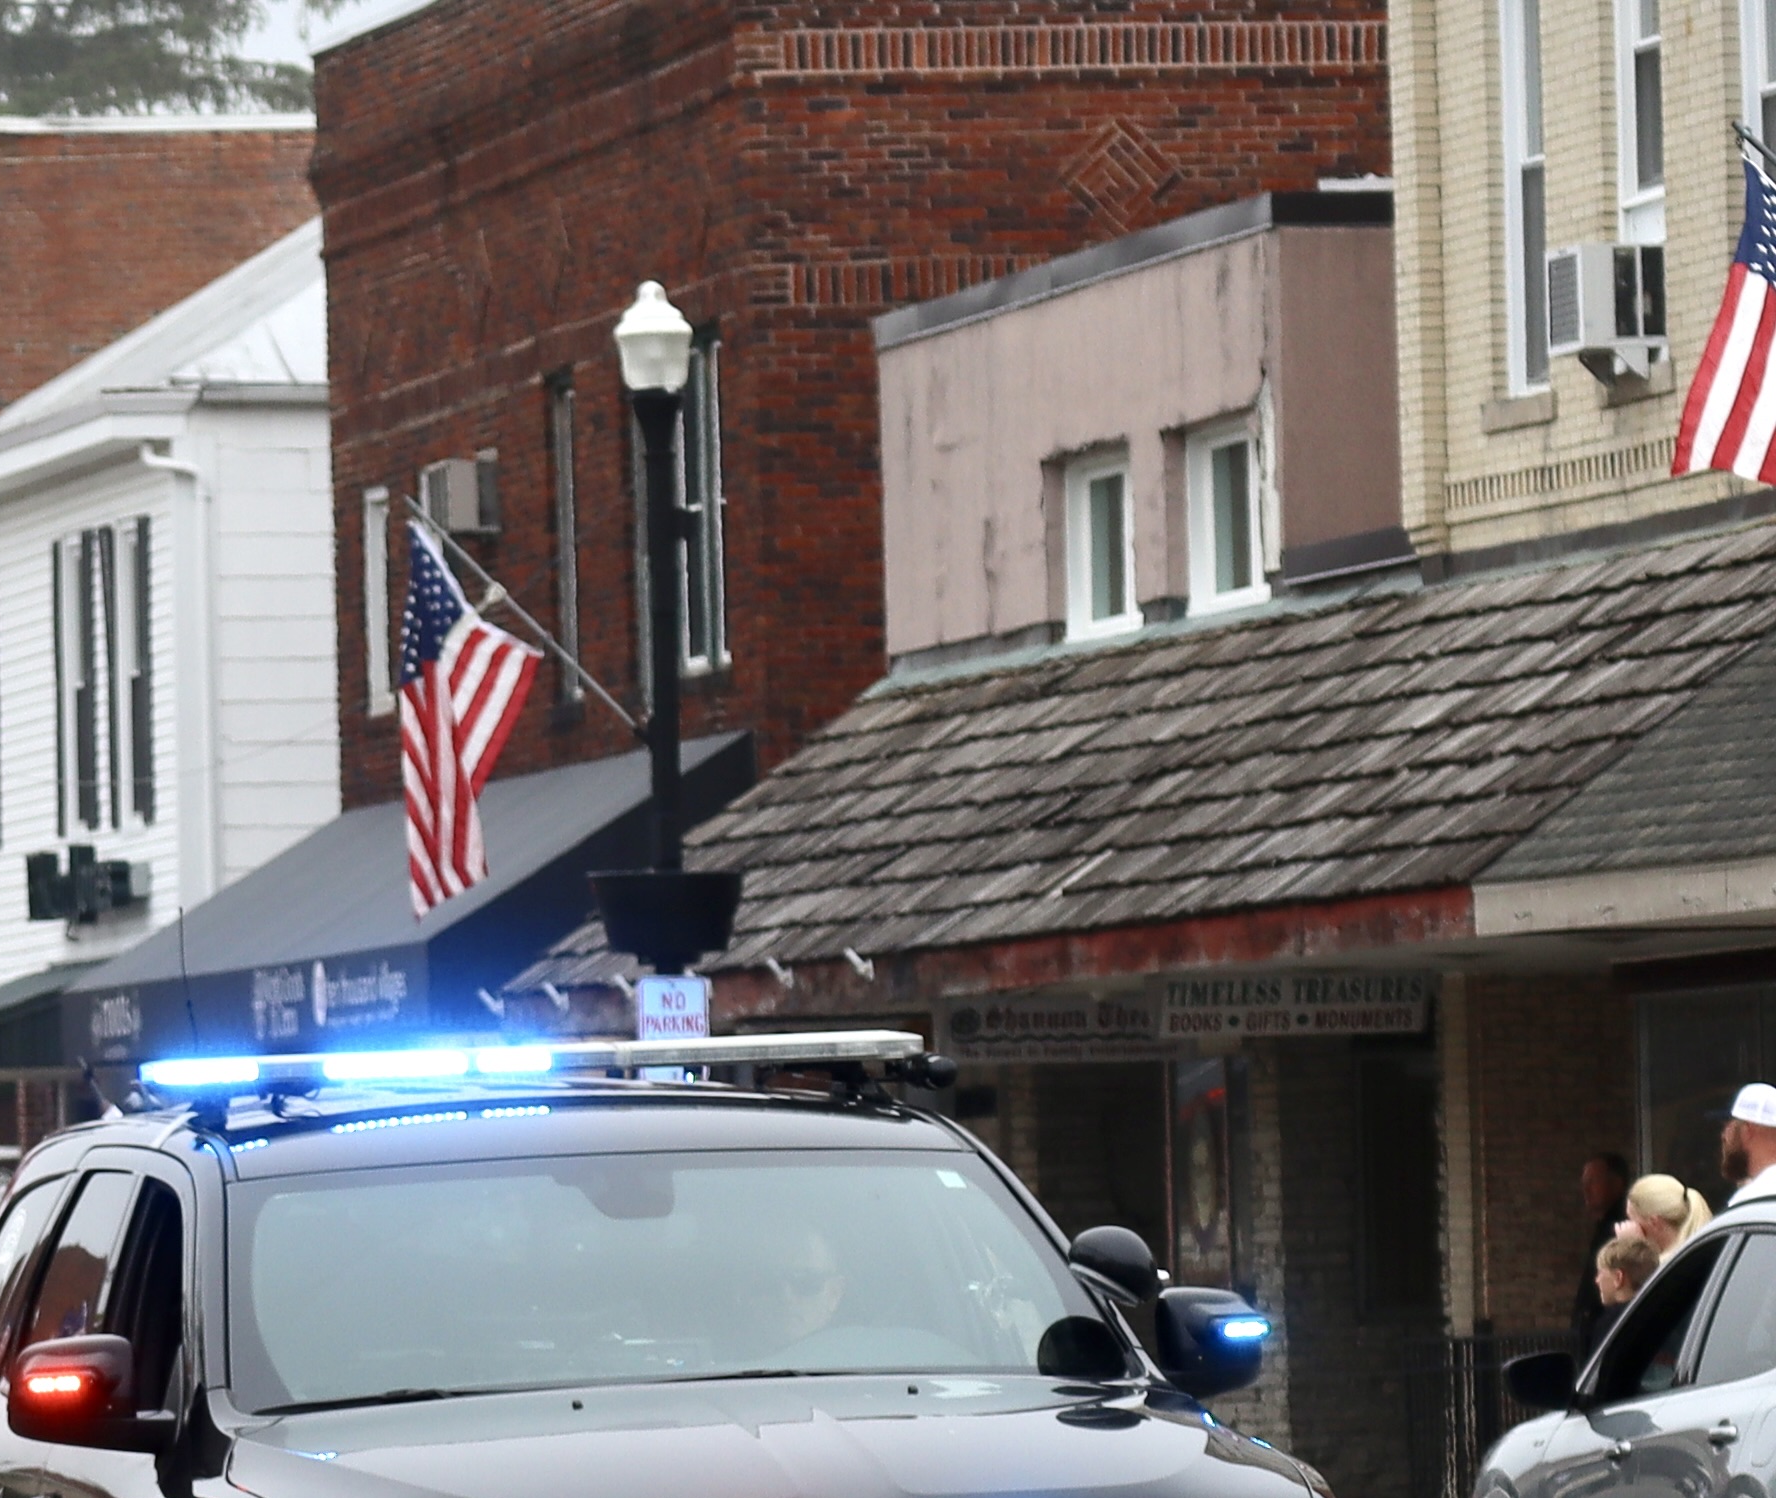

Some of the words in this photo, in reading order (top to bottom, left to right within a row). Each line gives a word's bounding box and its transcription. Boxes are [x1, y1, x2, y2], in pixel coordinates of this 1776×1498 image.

[661, 991, 686, 1011] NO
[1167, 977, 1282, 1006] TIMELESS
[1292, 976, 1422, 1005] TREASURES
[645, 1013, 705, 1033] PARKING
[1169, 1011, 1223, 1033] BOOKS
[1245, 1009, 1291, 1031] GIFTS
[1314, 1007, 1414, 1029] MONUMENTS
